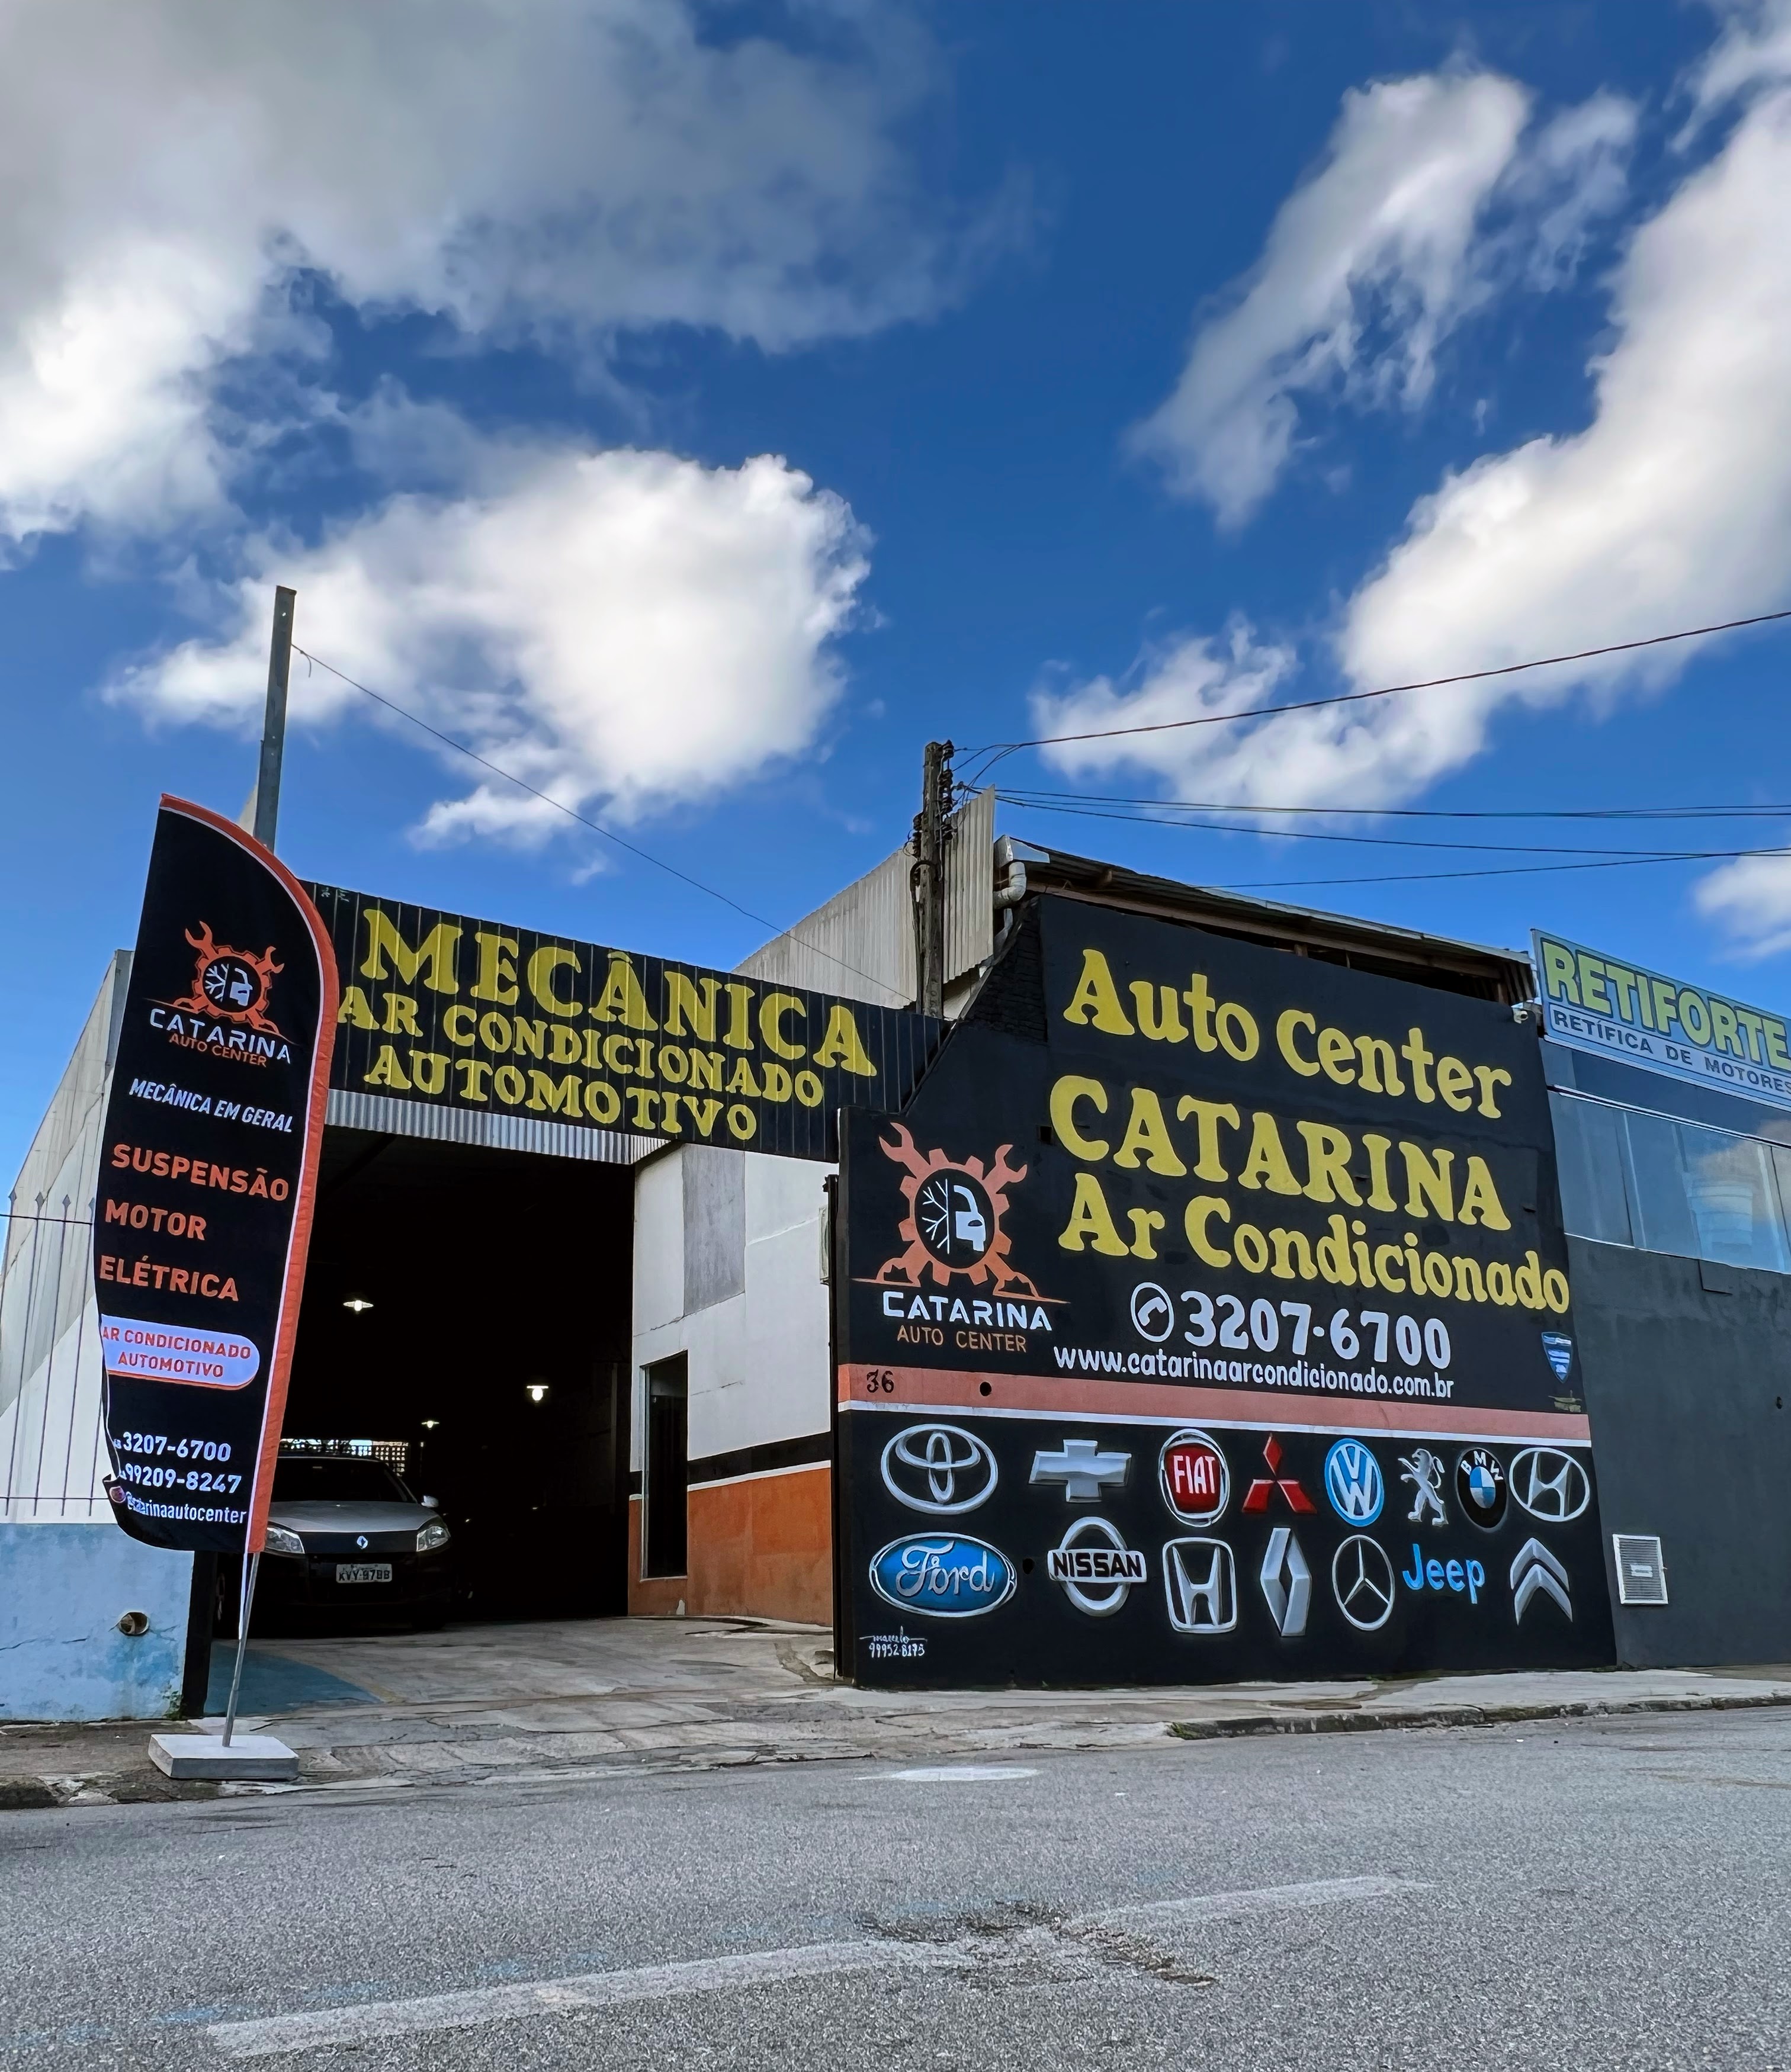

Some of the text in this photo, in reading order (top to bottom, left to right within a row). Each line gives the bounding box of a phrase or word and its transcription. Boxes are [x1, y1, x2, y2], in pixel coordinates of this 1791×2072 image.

[360, 908, 877, 1077] MECÂNICA
[1541, 937, 1791, 1072] RETIFORTE
[150, 1008, 291, 1064] CATARINA
[169, 1033, 267, 1066] AUTO CENTER
[338, 986, 824, 1107] AR CONDICIONADO
[1064, 949, 1511, 1119] Auto Center
[1553, 1010, 1653, 1054] RETÍFICA
[1665, 1045, 1693, 1065] DE
[129, 1078, 293, 1132] MECÂNICA EM GERAL
[364, 1045, 757, 1140] AUTOMOTIVO
[112, 1143, 288, 1201] SUSPENSÃO
[1050, 1075, 1511, 1231] CATARINA
[105, 1199, 207, 1241] MOTOR
[1058, 1172, 1569, 1313] Ar Condicionado
[100, 1255, 239, 1302] ELÉTRICA
[883, 1291, 1052, 1331] CATARINA
[103, 1326, 251, 1360] AR CONDICIONADO
[118, 1351, 224, 1377] AUTOMOTIVO
[897, 1325, 1026, 1353] AUTO CENTER
[866, 1369, 894, 1393] 36
[1054, 1346, 1454, 1398] www.catarinaarcondicionado.com.br
[123, 1432, 231, 1461] 3207-6700
[1460, 1451, 1503, 1480] BMW
[125, 1463, 242, 1493] 99209-8247
[1173, 1455, 1215, 1494] FIAT
[896, 1540, 994, 1597] Ford
[1052, 1552, 1142, 1578] NISSAN
[1402, 1543, 1485, 1604] Jeep
